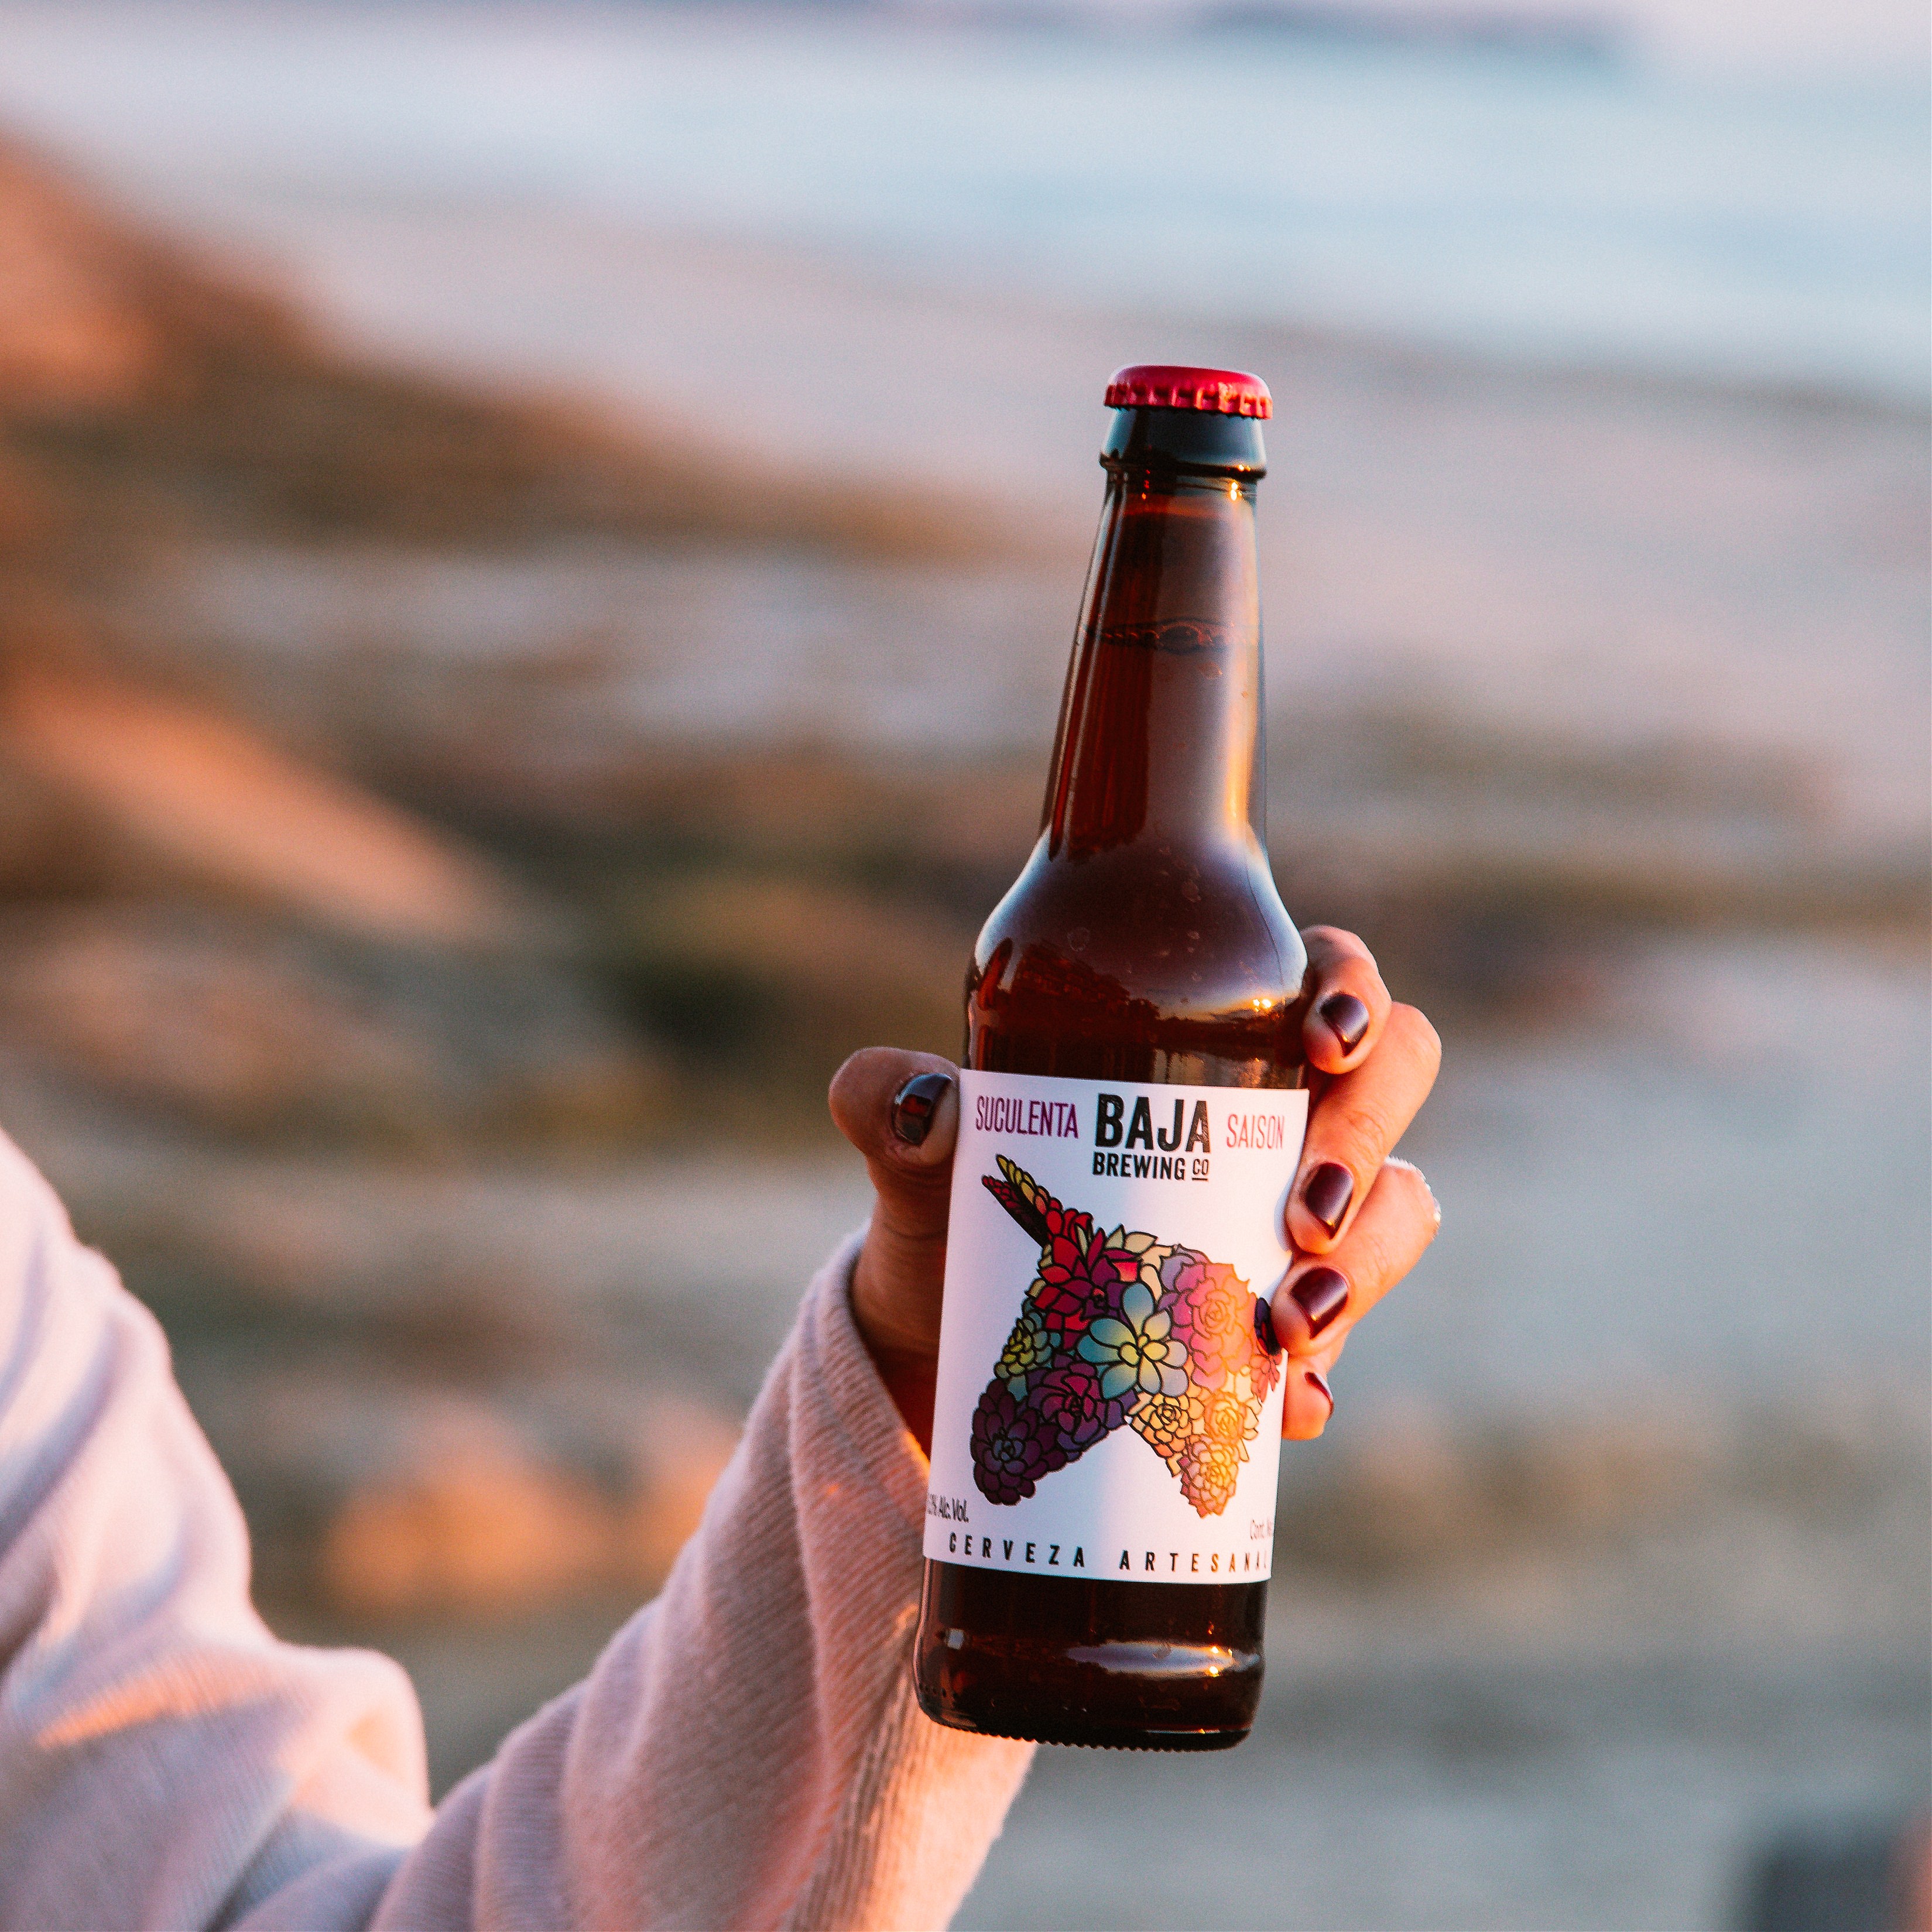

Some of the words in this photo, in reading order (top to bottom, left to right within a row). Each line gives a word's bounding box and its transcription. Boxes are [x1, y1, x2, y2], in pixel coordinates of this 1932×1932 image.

[976, 1095, 1079, 1139] SUCULENTA
[1095, 1093, 1211, 1153] BAJA
[1226, 1114, 1284, 1149] SAISON
[1092, 1152, 1186, 1181] BREWING
[1192, 1158, 1209, 1177] CO
[948, 1531, 1085, 1568] CERVEZA
